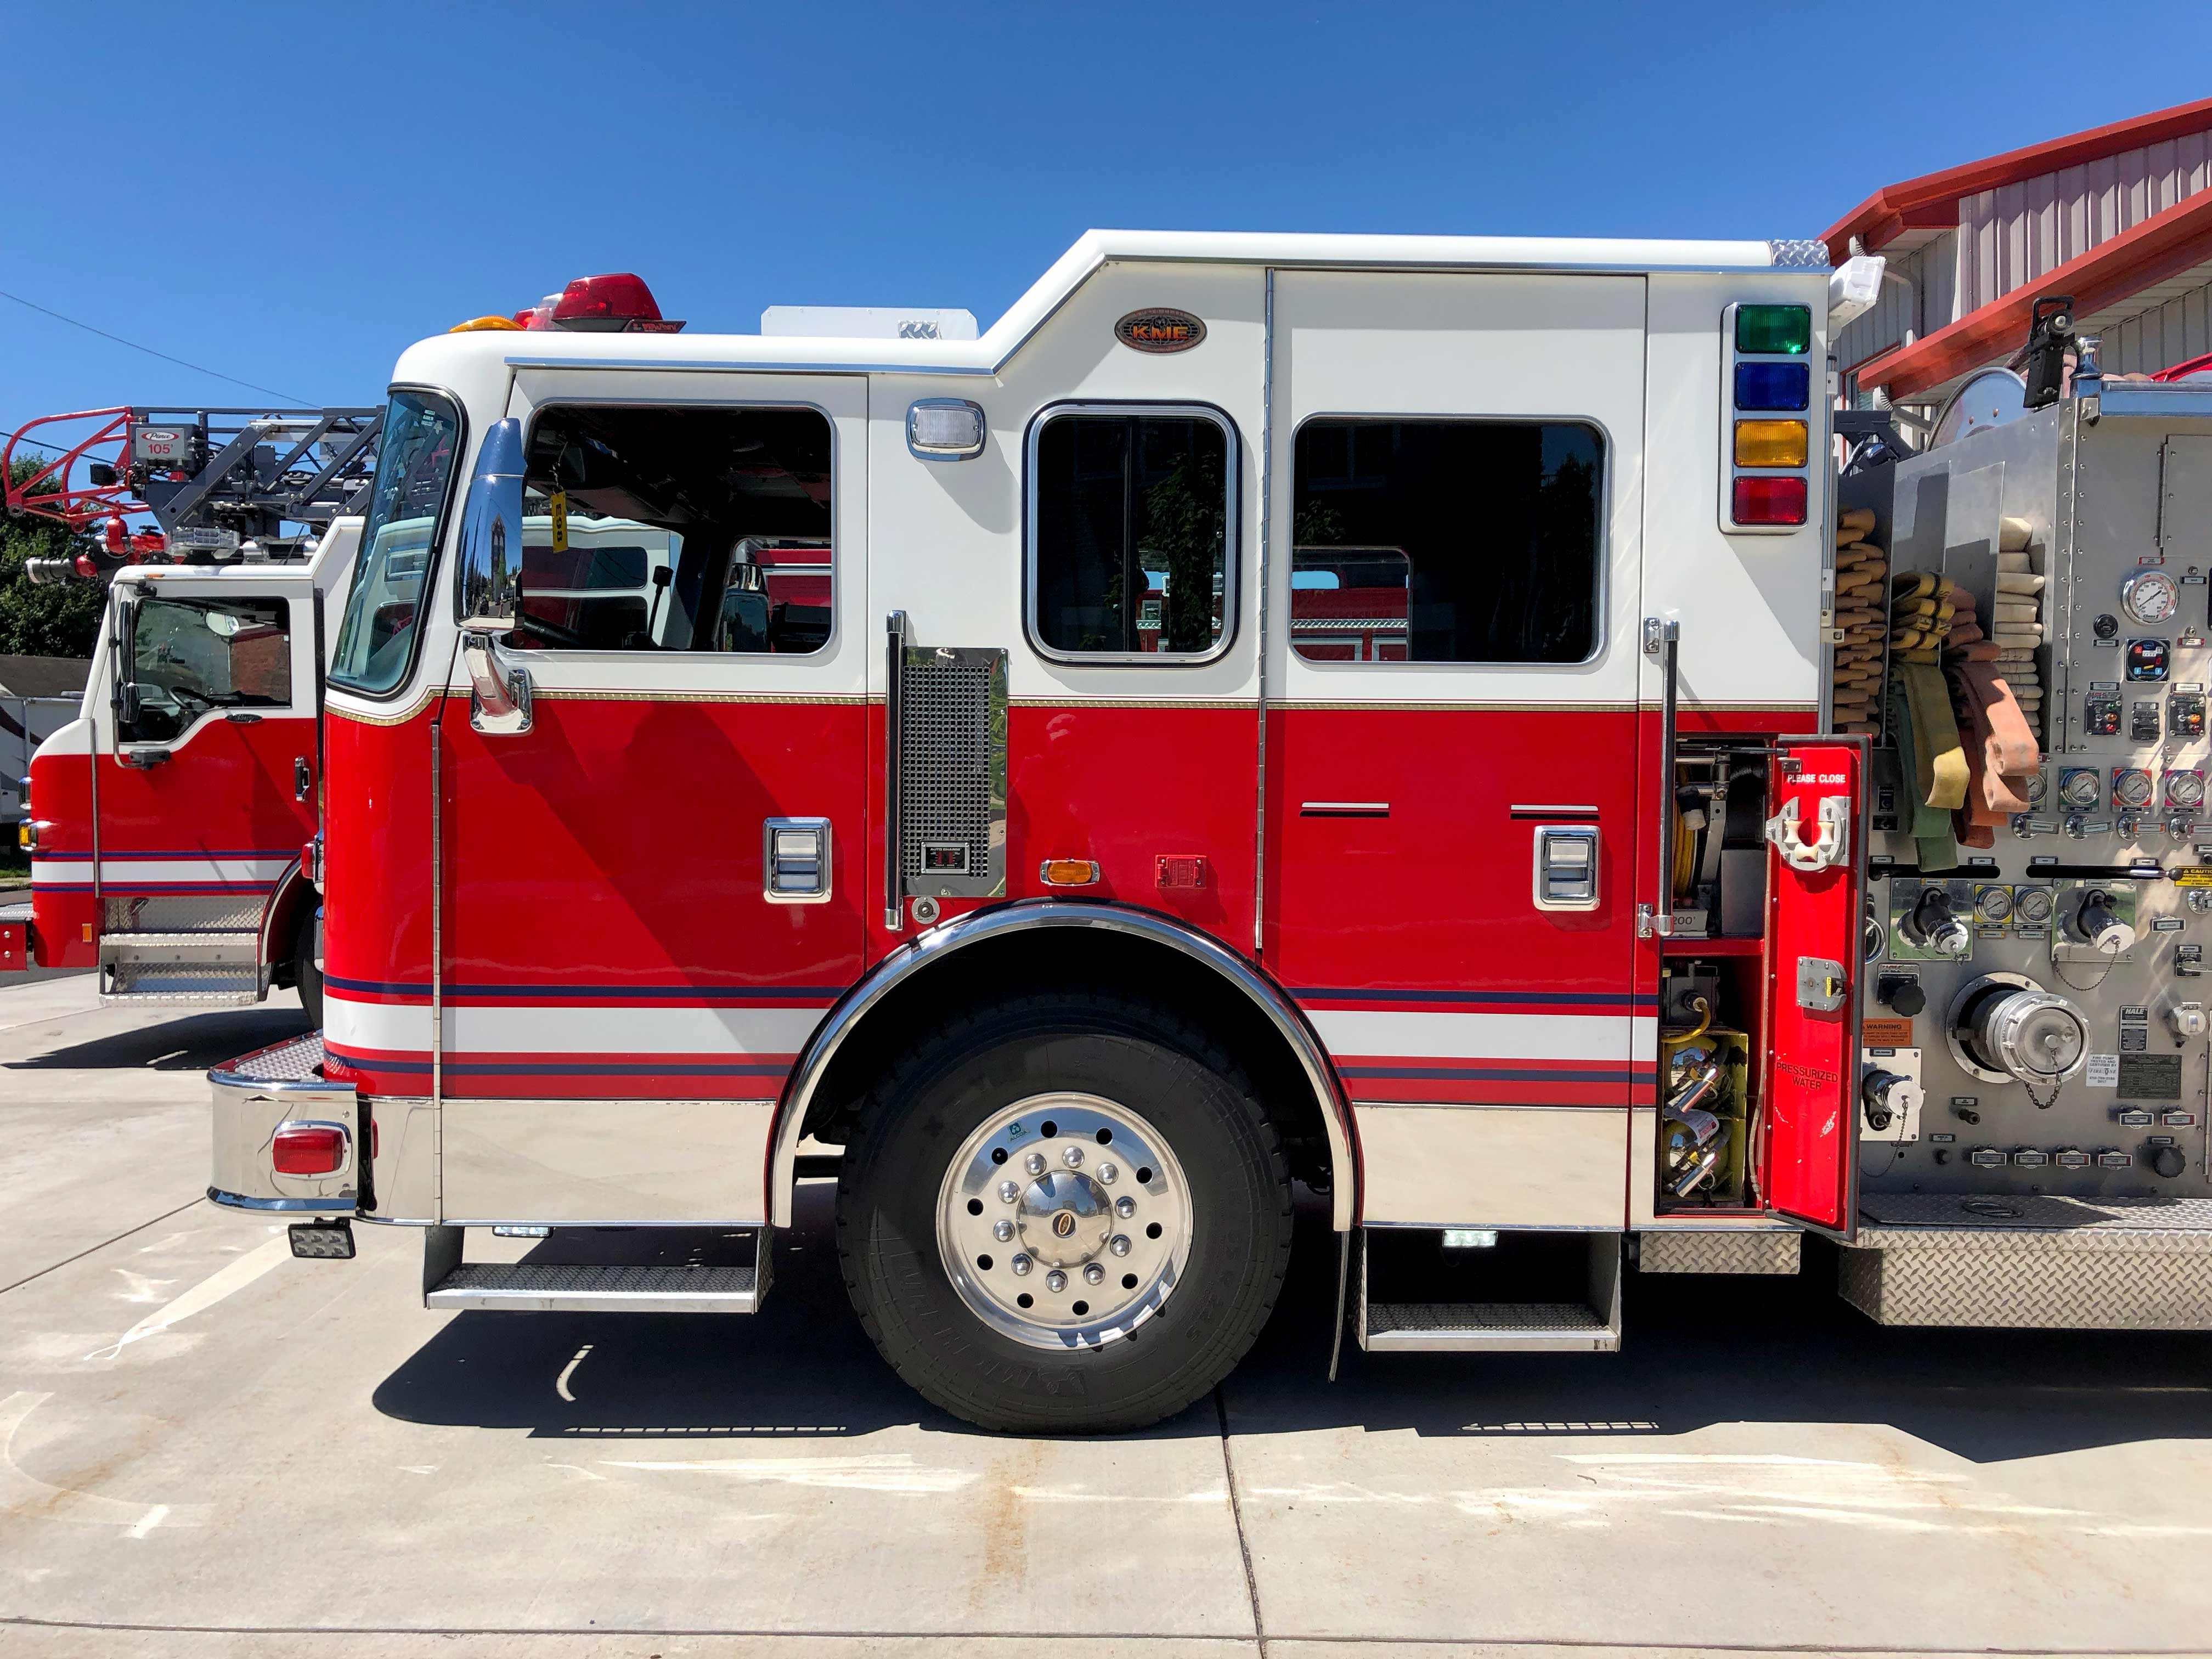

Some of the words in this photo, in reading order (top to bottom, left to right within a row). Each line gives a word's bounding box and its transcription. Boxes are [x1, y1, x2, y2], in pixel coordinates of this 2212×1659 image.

[1132, 325, 1189, 340] KME
[148, 444, 173, 454] 105'
[1787, 774, 1816, 783] PLEASE
[1819, 774, 1846, 783] CLOSE
[1776, 1062, 1838, 1082] PRESSURIZED
[1793, 1076, 1821, 1090] WATER
